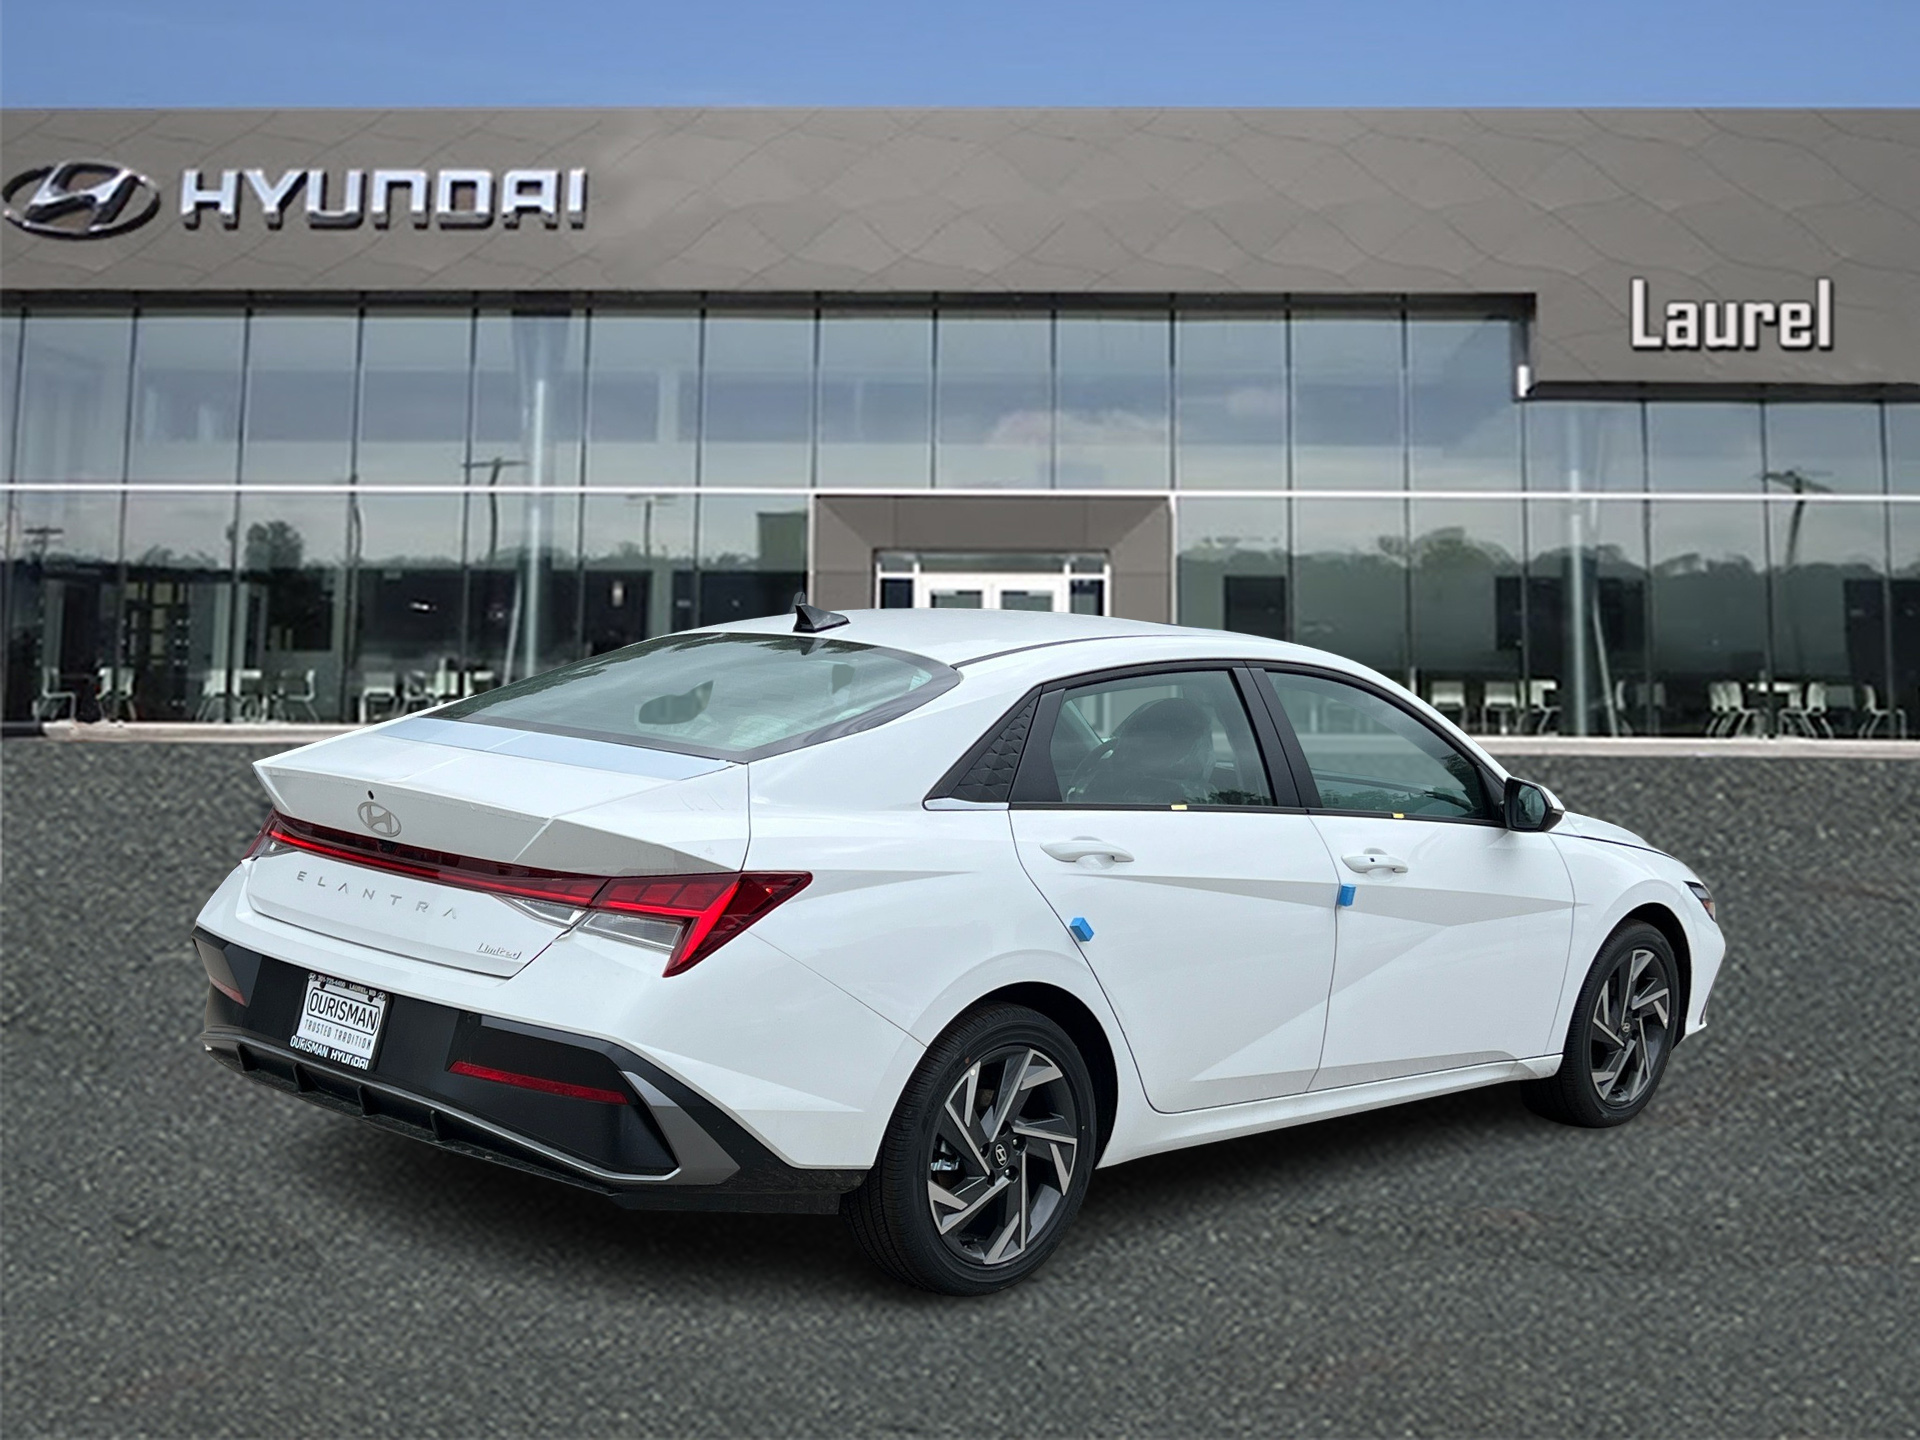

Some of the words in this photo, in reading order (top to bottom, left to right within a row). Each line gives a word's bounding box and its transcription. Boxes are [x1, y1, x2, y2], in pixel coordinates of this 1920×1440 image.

[180, 168, 587, 229] HYUNDAI
[1631, 278, 1832, 349] Laurel
[296, 870, 457, 920] ELANTRA
[476, 943, 522, 960] Limited
[309, 992, 377, 1031] OURISMAN
[289, 1035, 329, 1058] OURISMAN
[330, 1049, 369, 1070] HYUNDAI
[303, 1019, 332, 1038] TRUSTED
[334, 1028, 372, 1050] TRADITION
